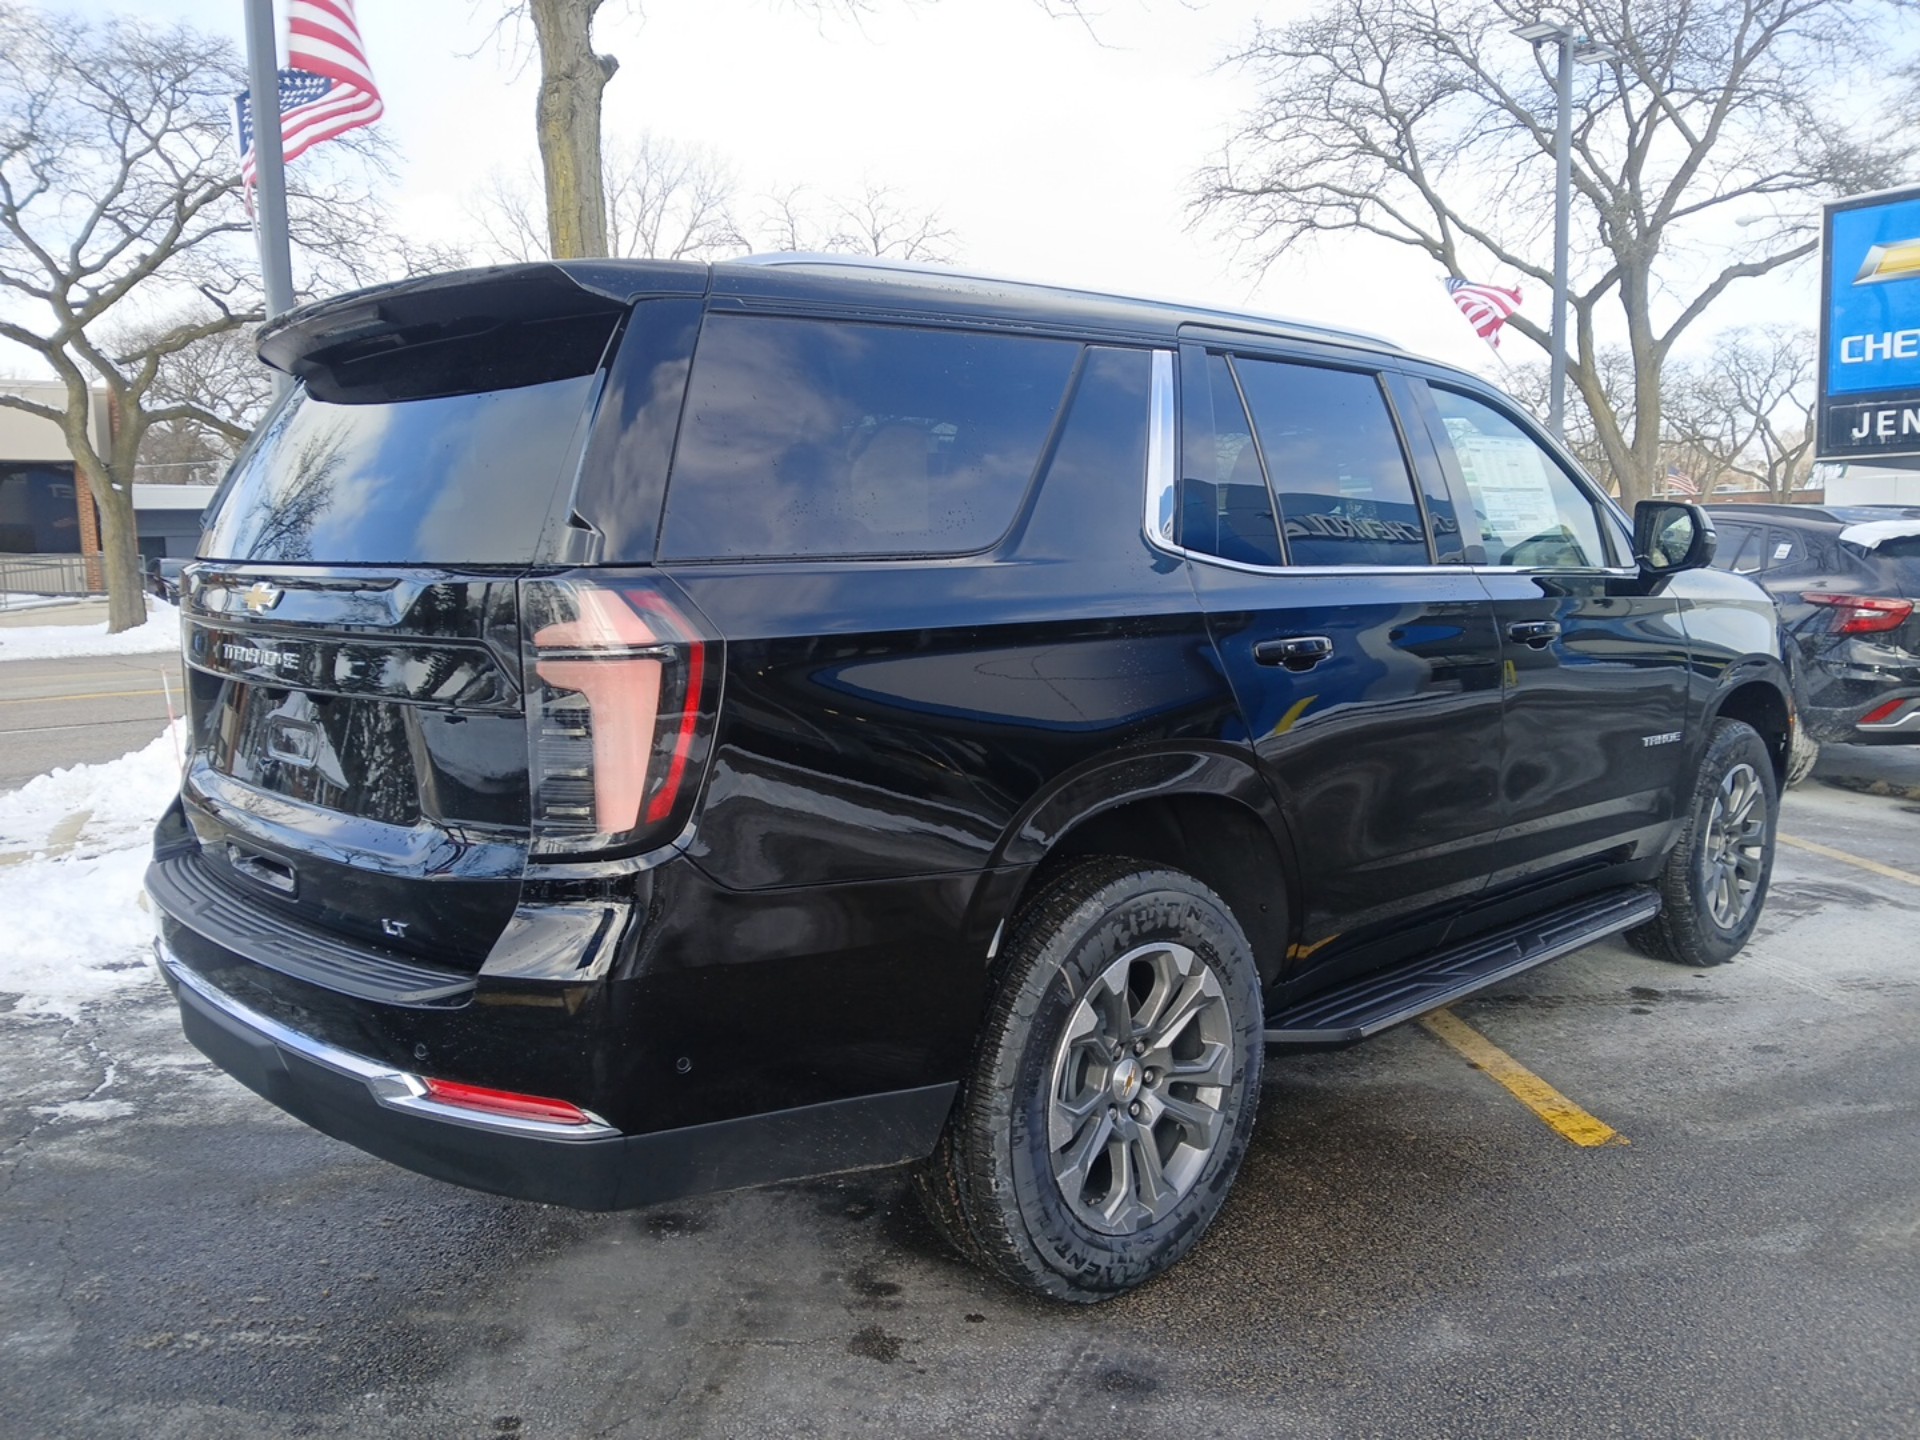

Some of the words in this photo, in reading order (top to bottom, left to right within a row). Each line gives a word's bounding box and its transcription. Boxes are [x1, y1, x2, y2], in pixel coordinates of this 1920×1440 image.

[1851, 408, 1920, 438] JEN
[1642, 731, 1682, 747] TAHOE
[381, 918, 409, 938] LT
